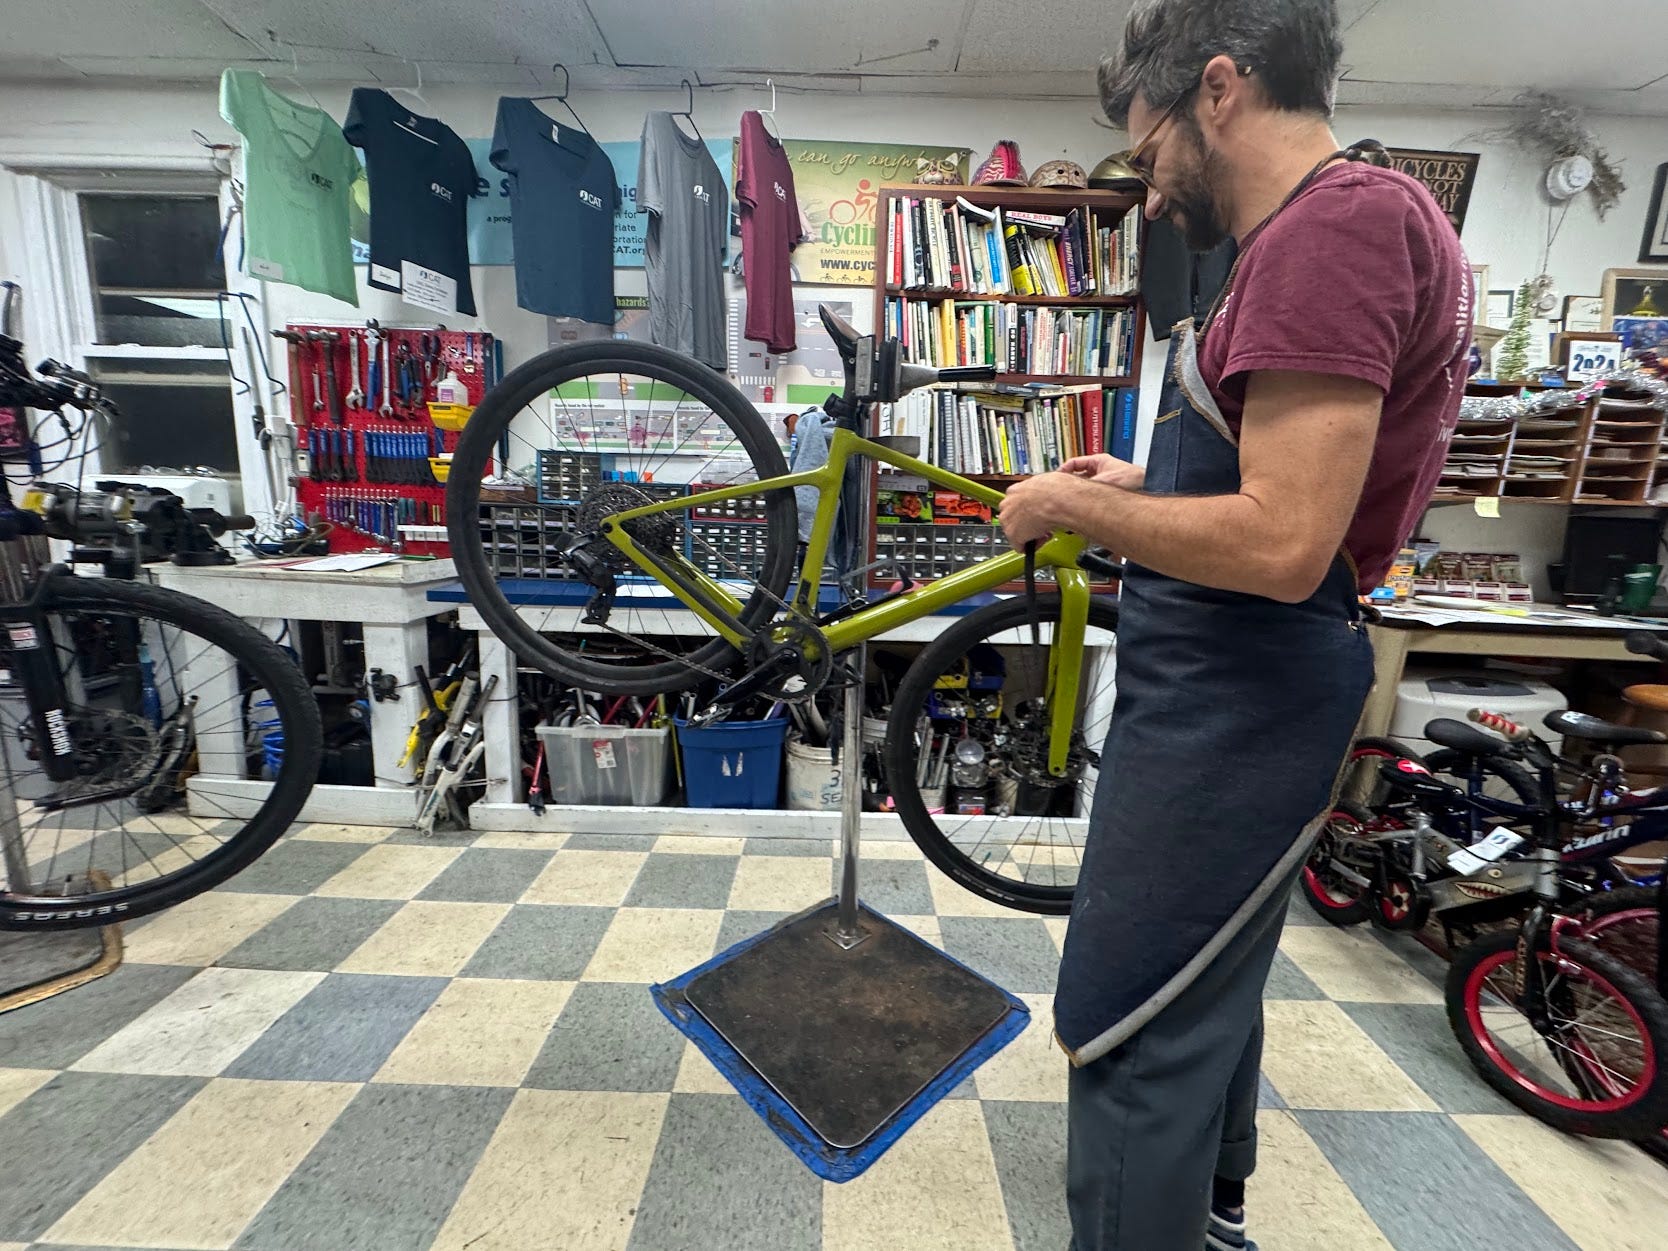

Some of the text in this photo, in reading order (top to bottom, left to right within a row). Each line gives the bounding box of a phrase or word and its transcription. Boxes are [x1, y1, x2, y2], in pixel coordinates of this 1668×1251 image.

[798, 150, 832, 164] can
[831, 153, 861, 175] go
[588, 195, 602, 208] CAT
[1011, 211, 1053, 221] REAL BOYS
